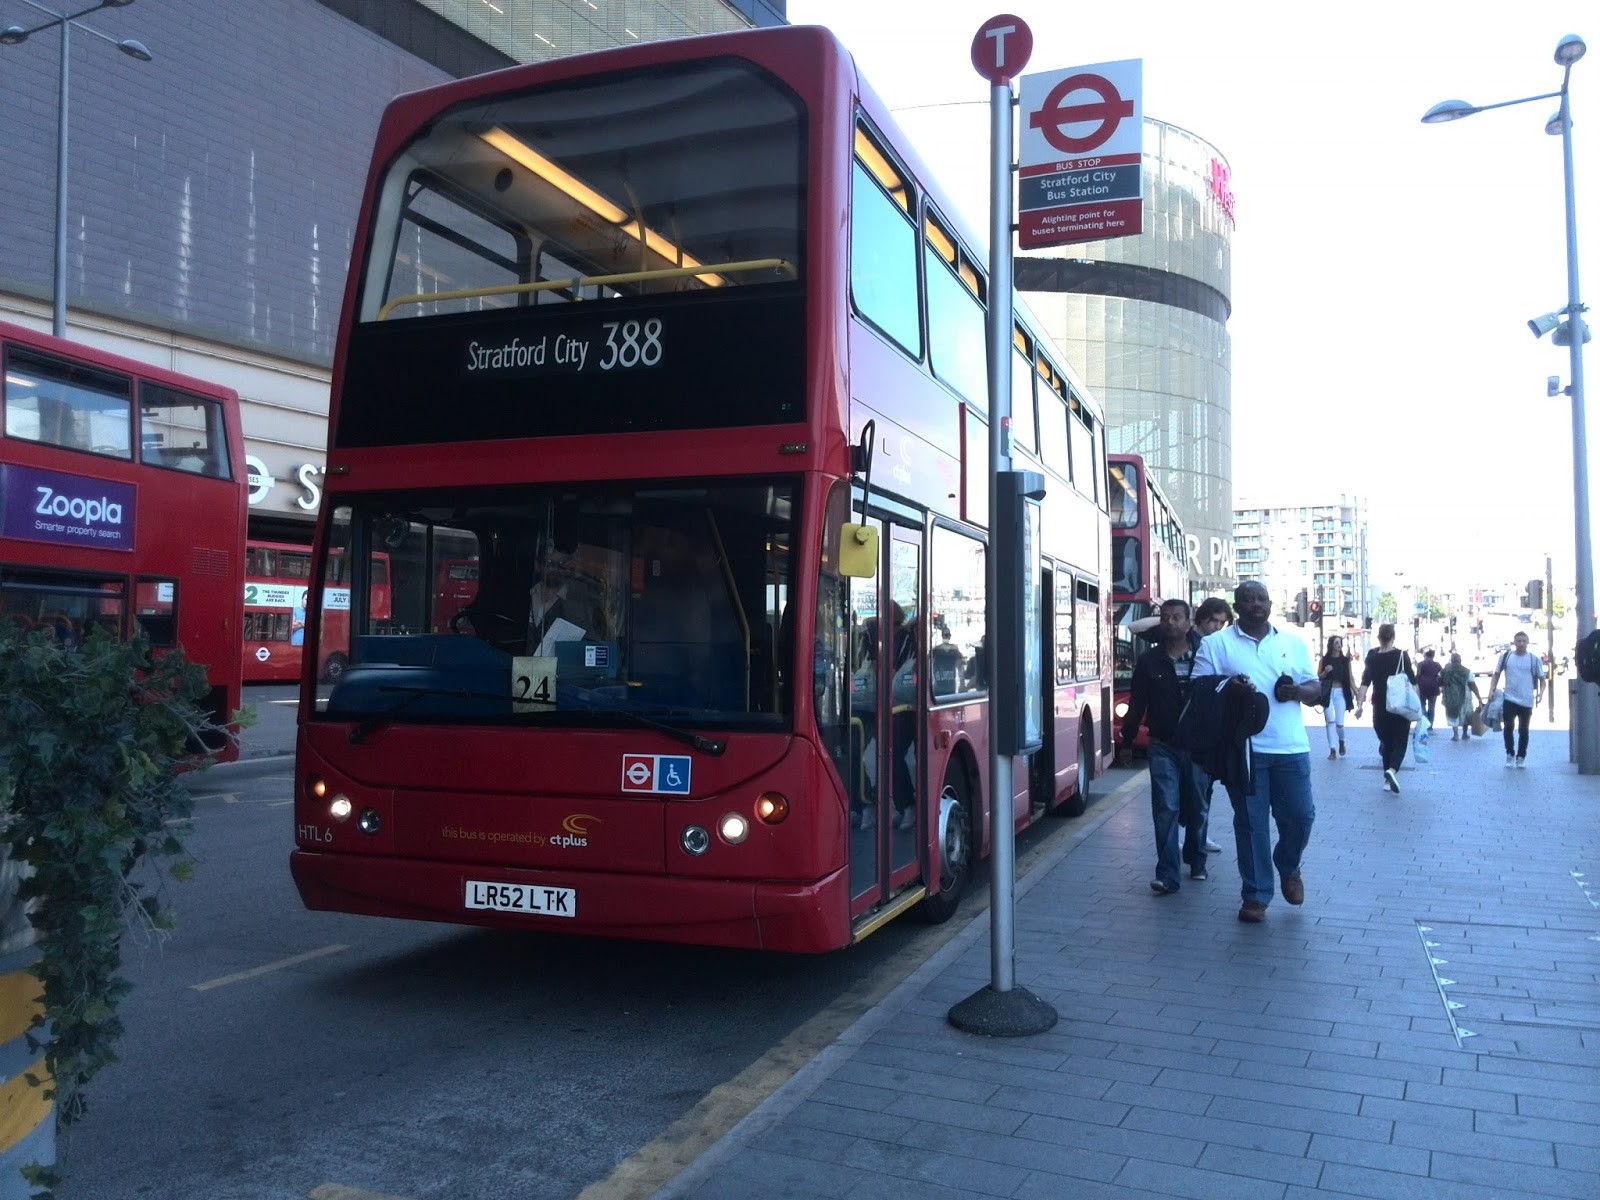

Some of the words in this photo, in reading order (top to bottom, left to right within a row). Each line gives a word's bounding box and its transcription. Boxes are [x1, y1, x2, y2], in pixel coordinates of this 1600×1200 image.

[986, 25, 1016, 68] T
[1056, 161, 1073, 171] BUS
[1078, 158, 1101, 168] STOP
[1040, 174, 1089, 189] Stratford
[1093, 172, 1116, 182] City
[1047, 191, 1066, 200] Bus
[1070, 186, 1109, 197] Station
[1032, 226, 1055, 236] buses
[1057, 220, 1104, 233] terminating
[1106, 219, 1125, 228] here
[1042, 214, 1077, 224] Alighting
[1080, 211, 1101, 221] point
[467, 336, 546, 371] Stratford
[554, 334, 589, 371] City
[600, 318, 662, 370] 388
[248, 476, 259, 484] SES
[297, 463, 326, 510] S
[36, 486, 122, 525] Zoopla
[35, 520, 65, 532] Smarter
[67, 525, 97, 538] property
[98, 528, 121, 539] search
[1185, 533, 1204, 575] R
[1210, 536, 1237, 580] PAR
[516, 676, 550, 701] 24
[299, 824, 322, 841] HTL
[325, 827, 333, 842] 6
[442, 826, 458, 838] this
[459, 827, 477, 840] bus
[479, 829, 486, 840] is
[488, 830, 532, 843] operated
[533, 830, 546, 847] by
[474, 884, 523, 909] LR52
[530, 889, 568, 912] LTK
